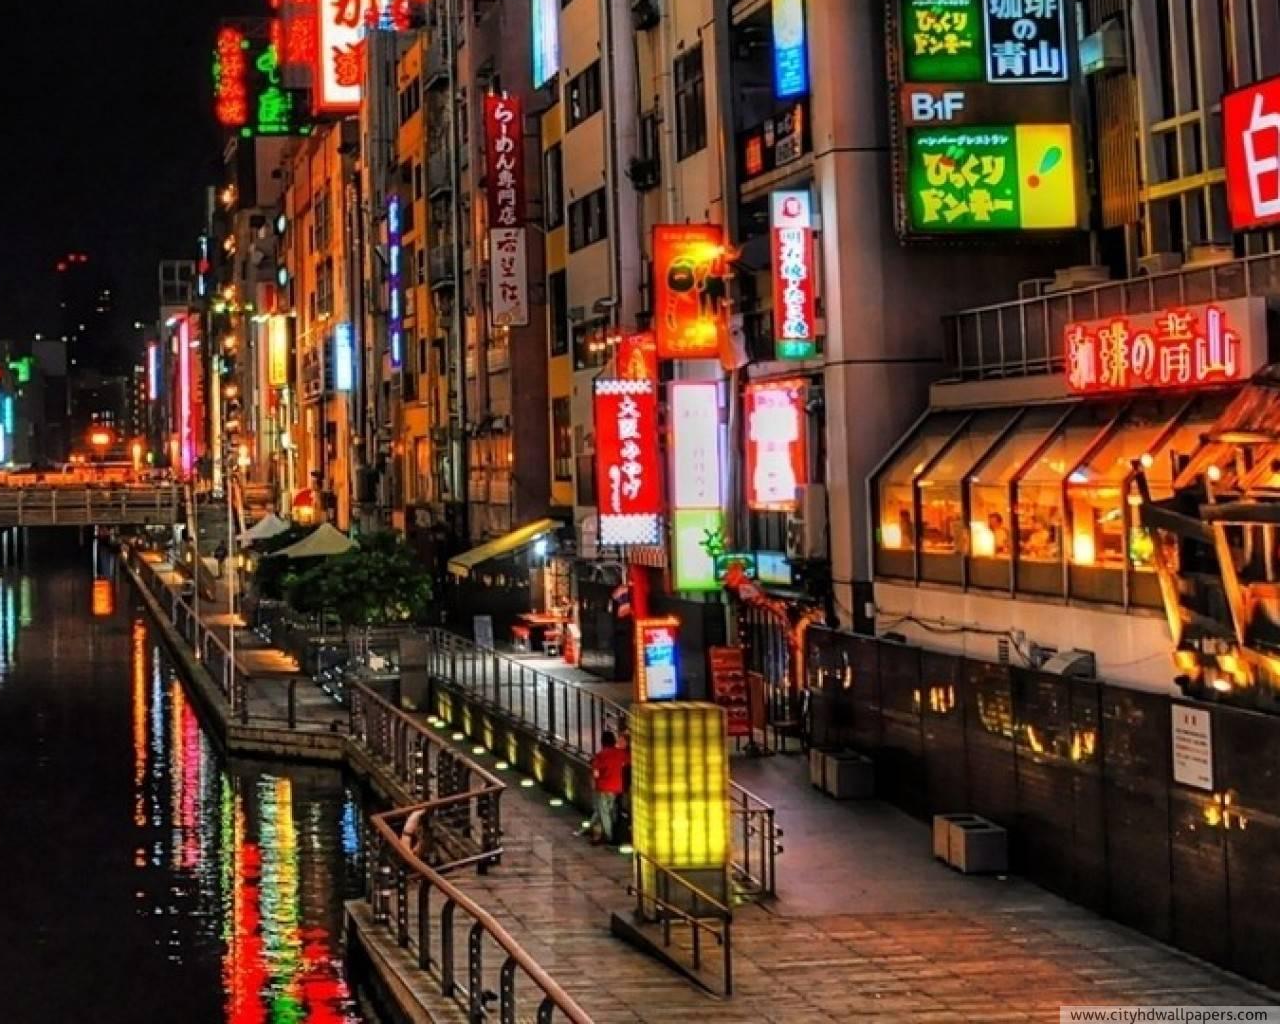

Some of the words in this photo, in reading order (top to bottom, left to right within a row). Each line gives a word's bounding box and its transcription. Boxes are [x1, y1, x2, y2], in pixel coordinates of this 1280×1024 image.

[914, 10, 968, 33] びっくり
[1012, 19, 1038, 41] の
[913, 33, 973, 55] ドンキー
[992, 39, 1060, 77] 青山
[911, 92, 965, 121] B1F
[494, 102, 517, 225] らーめん専門店
[922, 153, 1006, 187] びっくり
[919, 187, 1014, 224] ドンキー
[1068, 308, 1236, 390] 珈琲の青山
